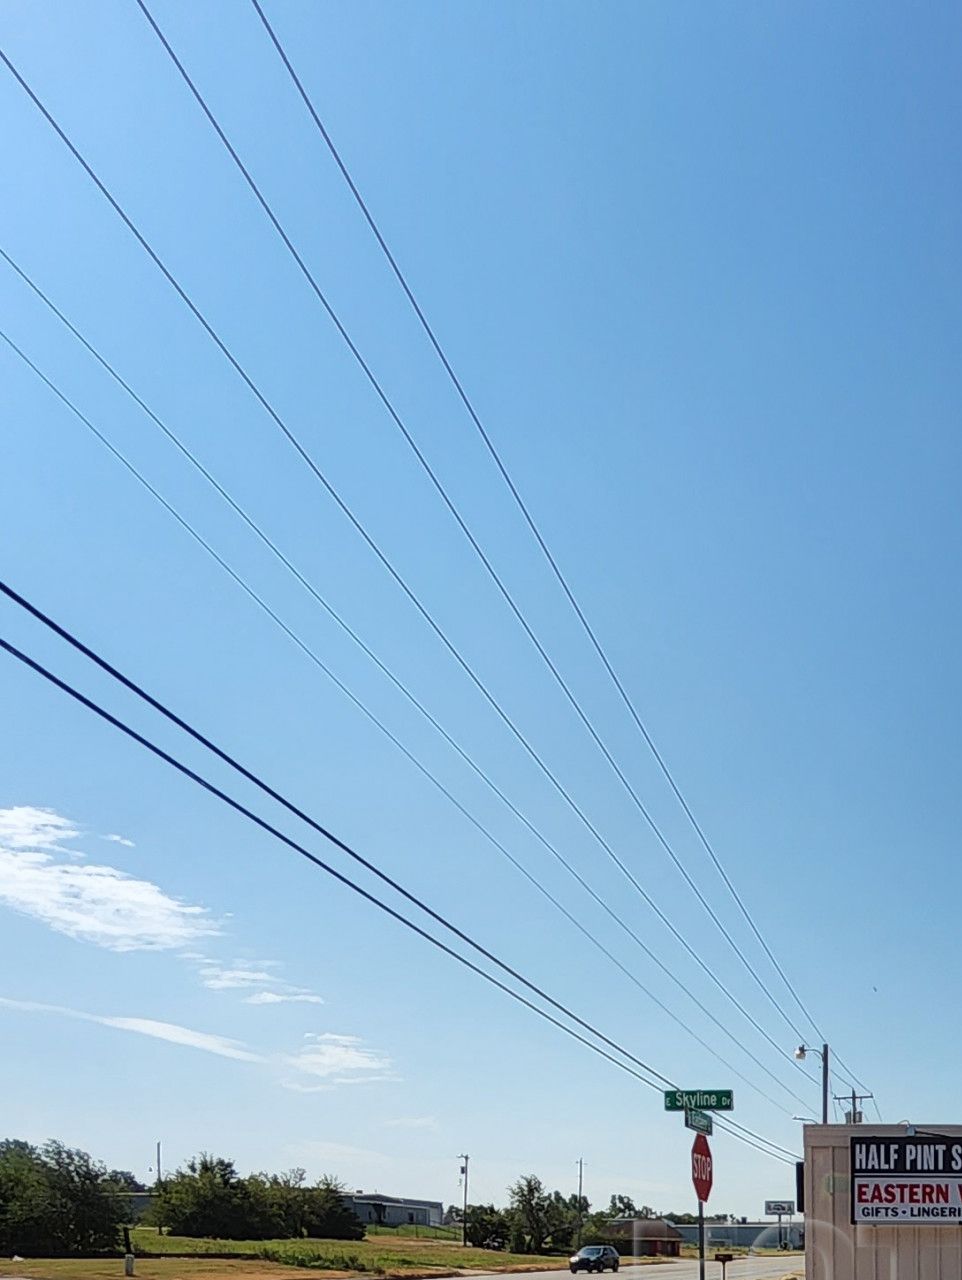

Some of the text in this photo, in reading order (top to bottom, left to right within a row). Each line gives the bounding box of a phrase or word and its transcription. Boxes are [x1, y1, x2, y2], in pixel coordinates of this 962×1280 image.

[665, 1091, 731, 1108] E Skyline Dr
[693, 1153, 712, 1182] STOP
[854, 1144, 899, 1170] HALF
[905, 1144, 947, 1171] PINT
[857, 1183, 949, 1204] EASTERN
[861, 1206, 899, 1218] GIFTS
